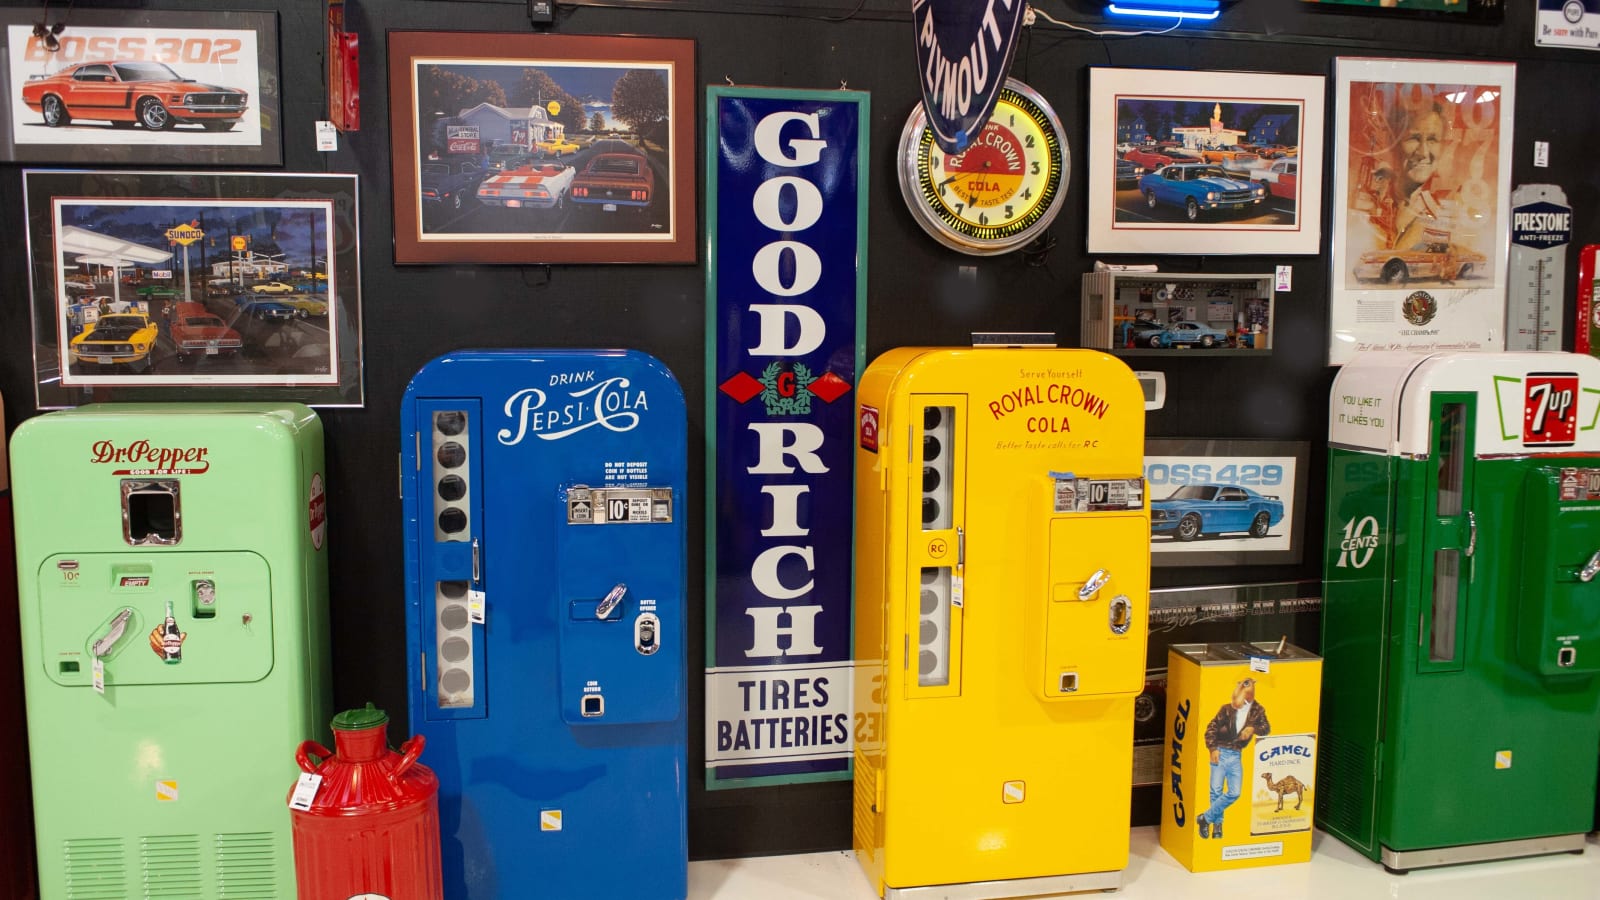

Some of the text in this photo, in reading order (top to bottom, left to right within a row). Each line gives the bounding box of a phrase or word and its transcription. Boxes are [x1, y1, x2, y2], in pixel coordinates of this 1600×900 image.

[1543, 24, 1599, 39] Be sure with Pure
[24, 35, 241, 65] BOSS 302
[920, 0, 1011, 120] PLYMOUT
[986, 131, 1021, 171] CROWN
[1031, 161, 1040, 175] 3
[953, 185, 970, 201] BEST
[1000, 187, 1014, 201] TEST
[968, 181, 1000, 192] COLA
[1020, 187, 1031, 200] 4
[1004, 205, 1014, 219] 5
[1514, 212, 1570, 231] PRESTONE
[169, 230, 201, 239] SUNOCO
[549, 370, 595, 387] DRINK
[1019, 369, 1083, 379] Serve Yourself
[988, 383, 1110, 421] ROYAL CROWN
[1342, 395, 1382, 407] YOU LIKE IT
[1027, 417, 1071, 433] COLA
[1338, 413, 1385, 427] IT LIKES YOU
[1144, 463, 1283, 486] OSS 429
[930, 543, 945, 553] RC
[1336, 515, 1379, 568] 10
[1340, 535, 1379, 552] CENTS
[124, 579, 148, 587] EMPTY
[737, 676, 829, 712] TIRES
[717, 713, 848, 752] BATTERIES
[1259, 744, 1312, 762] CAMEL
[1170, 698, 1191, 828] CAMEL
